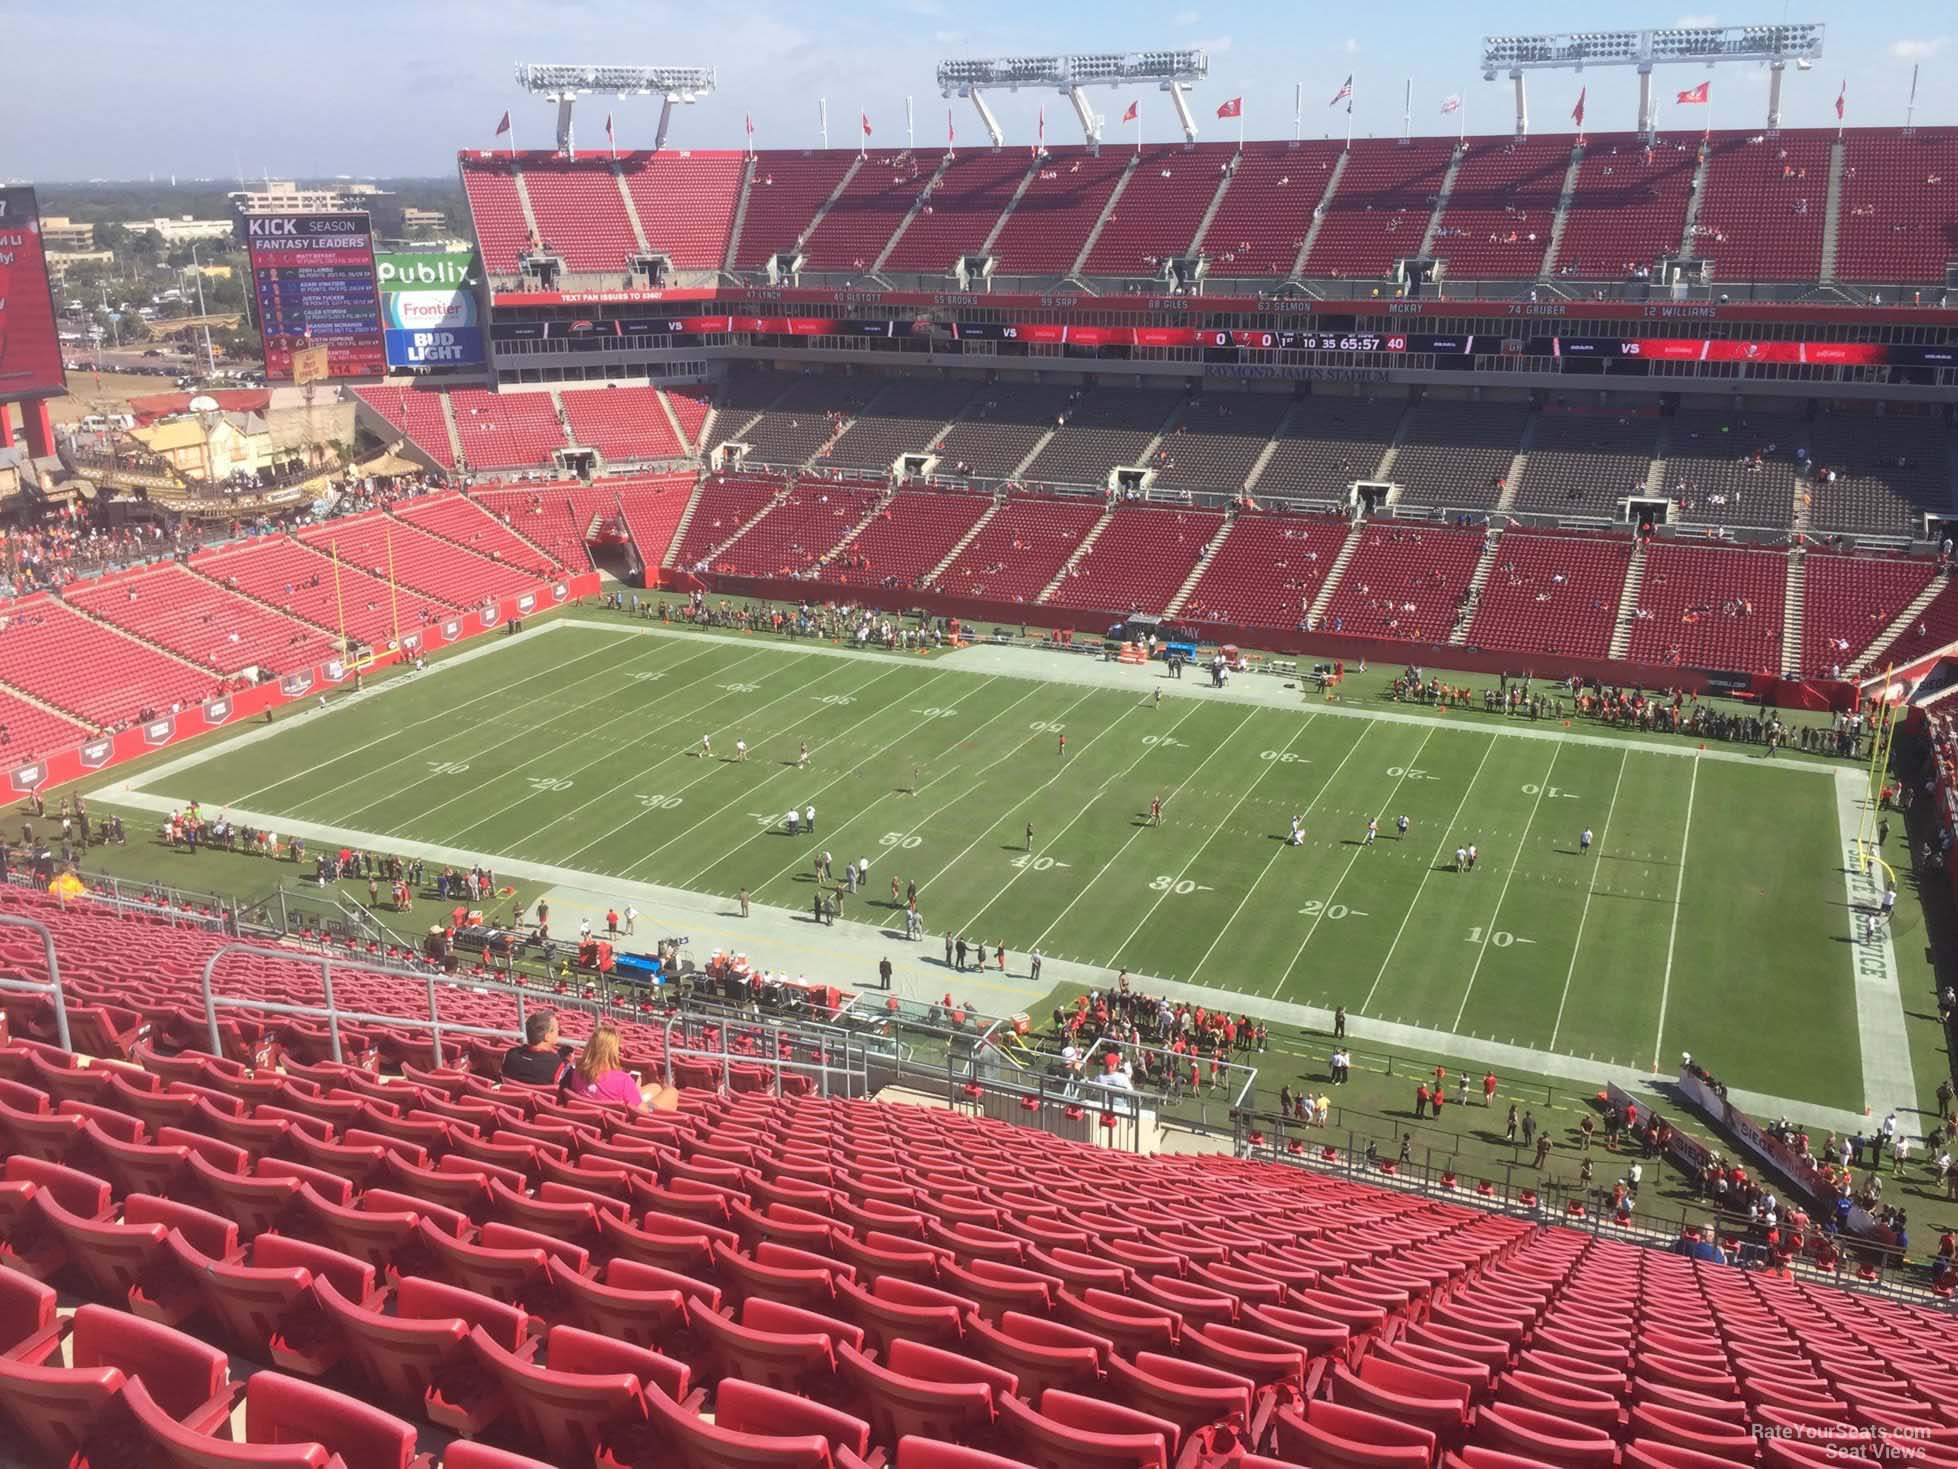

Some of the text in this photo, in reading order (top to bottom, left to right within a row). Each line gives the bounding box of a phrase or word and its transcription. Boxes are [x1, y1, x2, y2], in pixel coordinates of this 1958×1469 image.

[249, 219, 356, 235] KICK SEASON
[256, 238, 365, 249] FANTASY LEADERS
[379, 261, 478, 285] Publix
[561, 294, 581, 302] TEXT
[600, 293, 628, 301] ISSUES
[630, 292, 641, 300] TO
[758, 291, 782, 300] LYNCH
[947, 296, 978, 305] BROOKS
[404, 303, 463, 316] Frontier
[1164, 301, 1188, 309] GILES
[1273, 302, 1312, 312] SELMON
[1508, 305, 1566, 314] 74 GRUBER
[1643, 307, 1716, 317] 12 WILLIAMS
[668, 321, 683, 331] VS
[1003, 328, 1017, 338] VS
[413, 332, 455, 347] BUD
[1216, 334, 1226, 345] 0
[1261, 335, 1272, 346] 0
[1303, 339, 1316, 348] 10
[1322, 339, 1336, 349] 35
[1340, 338, 1380, 350] 65:57
[1387, 338, 1404, 349] 40
[407, 345, 463, 361] LIGHT
[1621, 343, 1640, 354] VS
[1204, 365, 1391, 382] RAYMOND JAMES STADIUM
[1181, 626, 1200, 639] DAY
[1029, 720, 1067, 733] 50
[1260, 750, 1300, 763] 30
[1386, 766, 1428, 780] 20
[1521, 783, 1563, 798] 10
[640, 794, 683, 809] 30
[878, 832, 923, 849] 50
[1008, 854, 1054, 871] 40
[1148, 875, 1196, 895] 30
[1297, 900, 1349, 920] 20
[1463, 927, 1514, 948] 10
